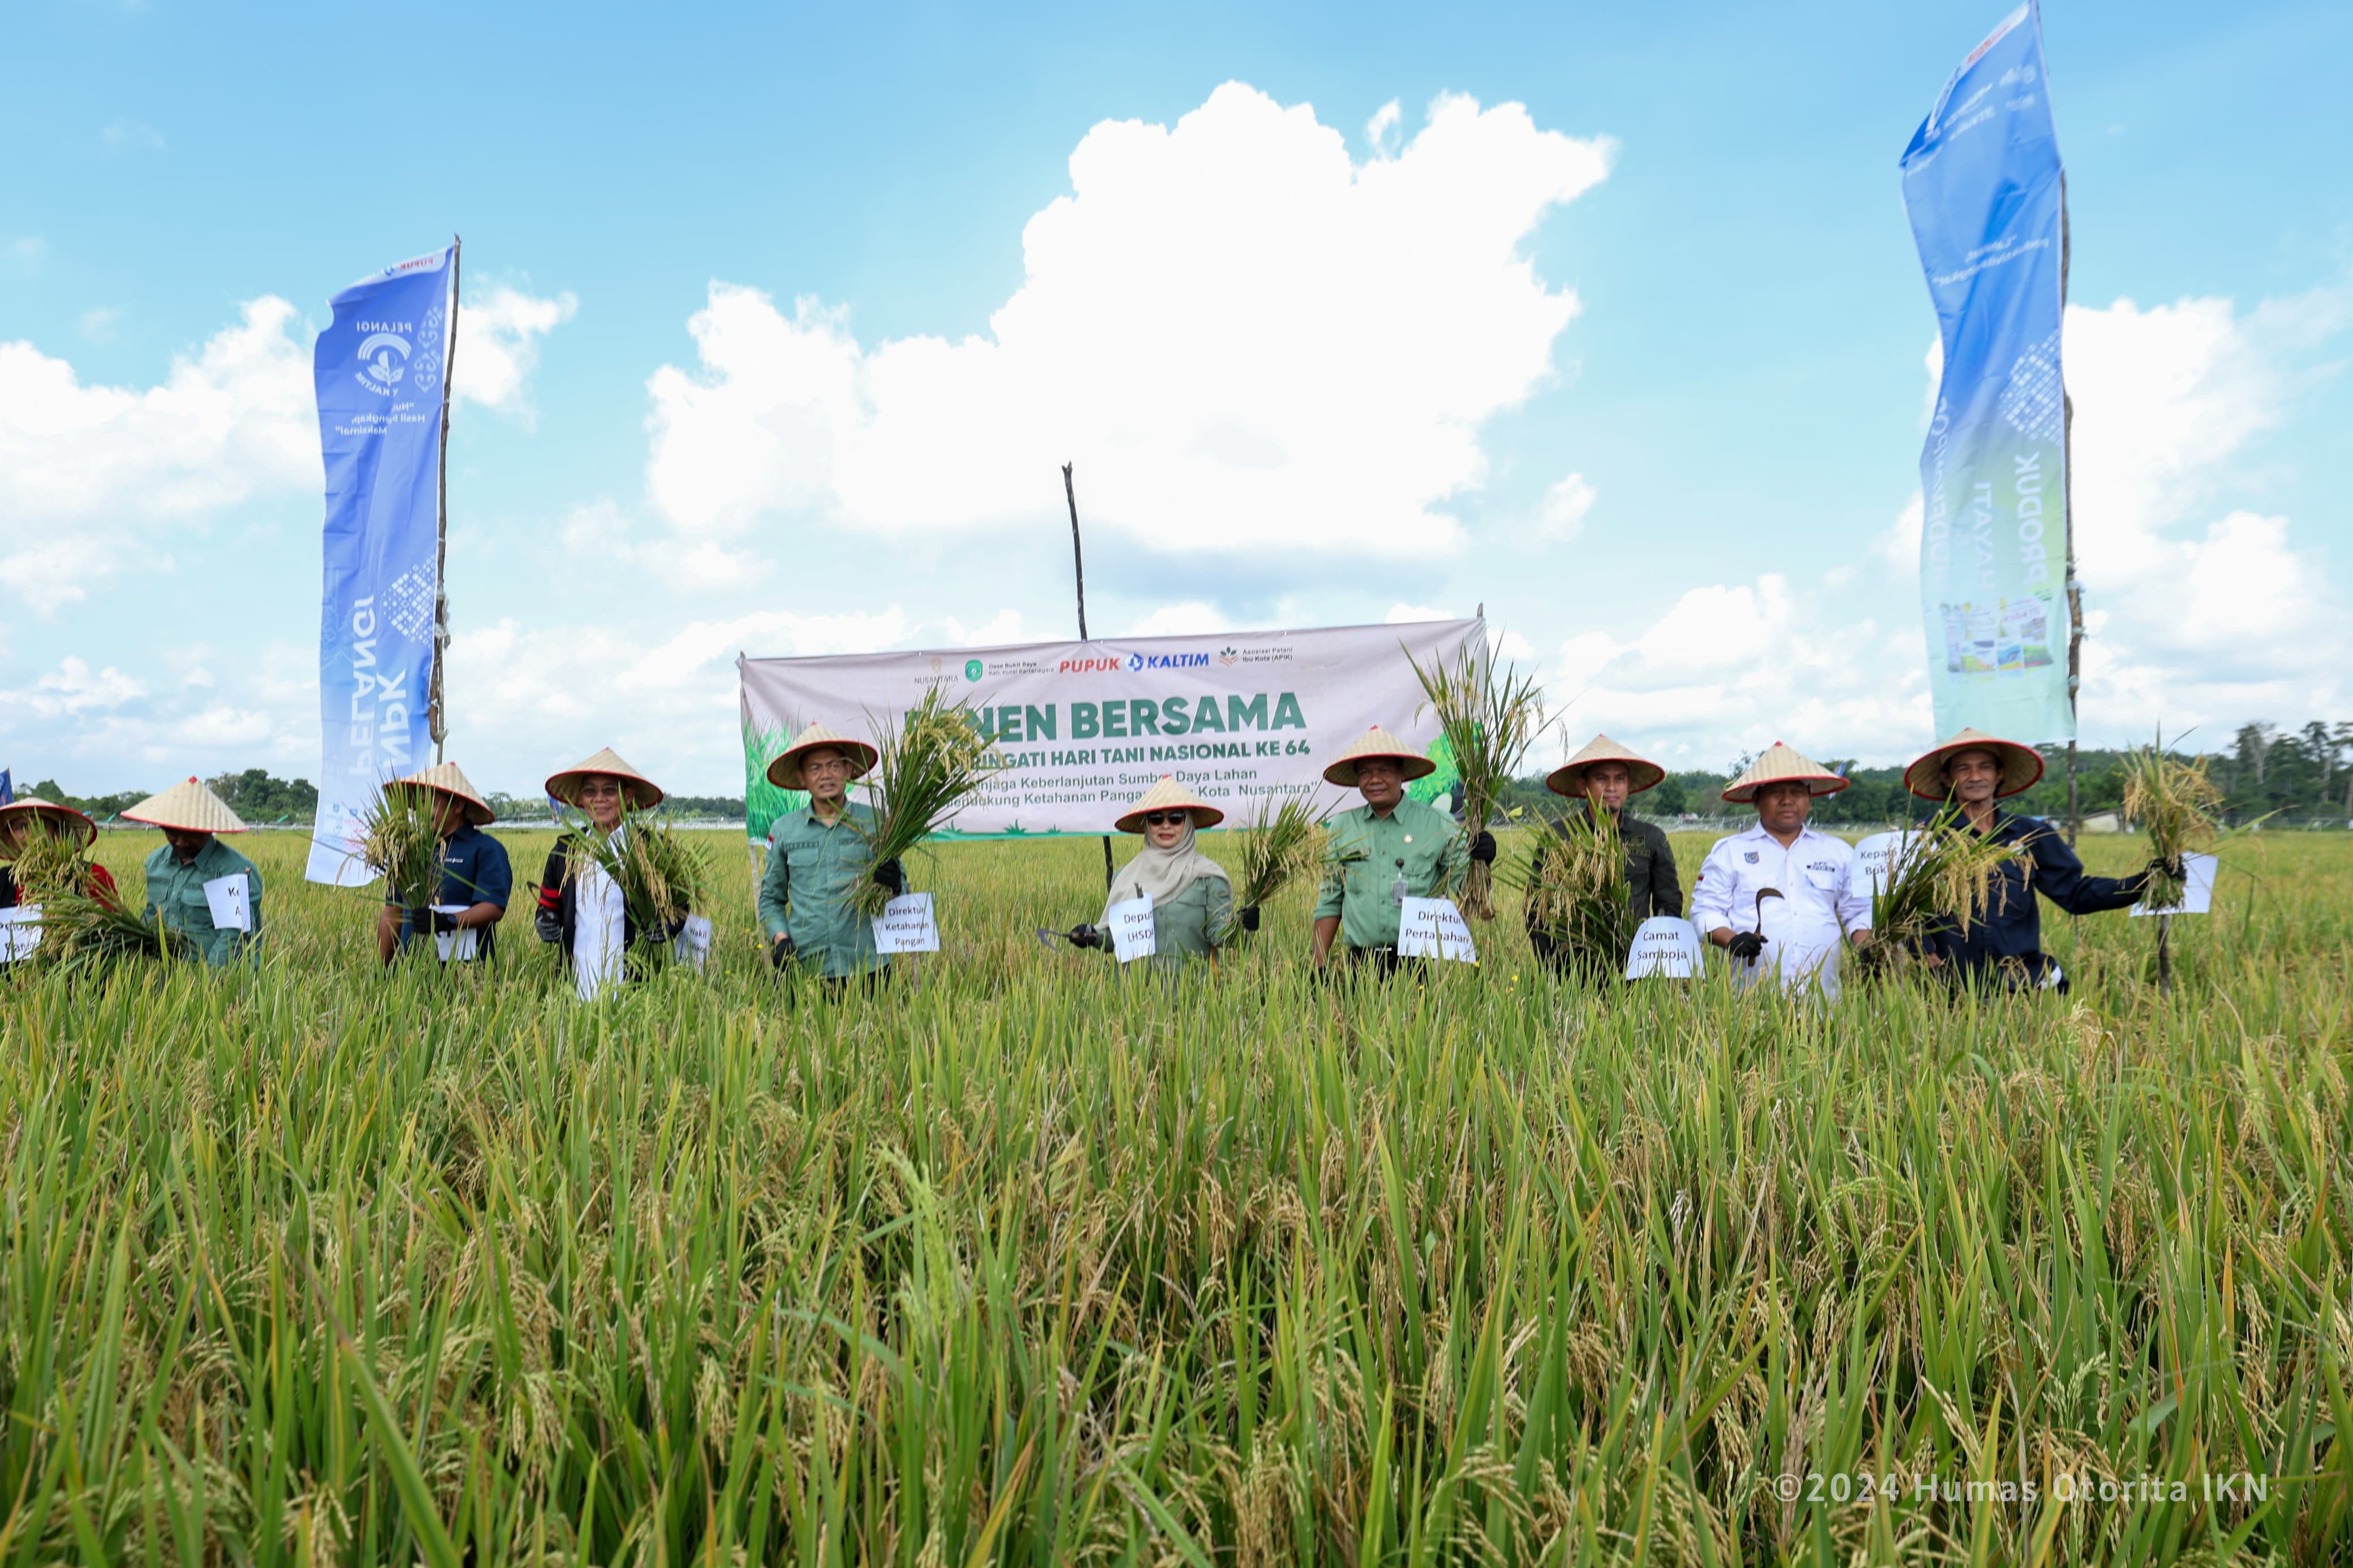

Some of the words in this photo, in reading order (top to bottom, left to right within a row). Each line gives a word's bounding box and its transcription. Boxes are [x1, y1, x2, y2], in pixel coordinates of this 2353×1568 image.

[1059, 658, 1121, 673] PUPUK
[1147, 653, 1209, 669] KALTIM
[914, 674, 959, 684] NUSANTARA
[904, 703, 1057, 748] NEN
[1071, 692, 1307, 740] BERSAMA
[1051, 749, 1096, 766] HARI
[1101, 746, 1145, 764] TANI
[1150, 741, 1251, 762] NASIONAL
[1256, 741, 1280, 757] KE
[1285, 739, 1311, 756] 64
[1020, 775, 1114, 790] Keberlanjutan
[1176, 770, 1210, 785] Daya
[1215, 768, 1257, 781] Lahan
[1024, 792, 1096, 805] Ketahanan
[1101, 791, 1145, 804] Panga
[1198, 785, 1230, 798] Kota
[888, 906, 924, 917] Direktur
[885, 921, 929, 932] Ketahanan
[895, 938, 925, 947] Pangan
[1643, 930, 1680, 941] Camat
[1637, 948, 1687, 961] Samboja
